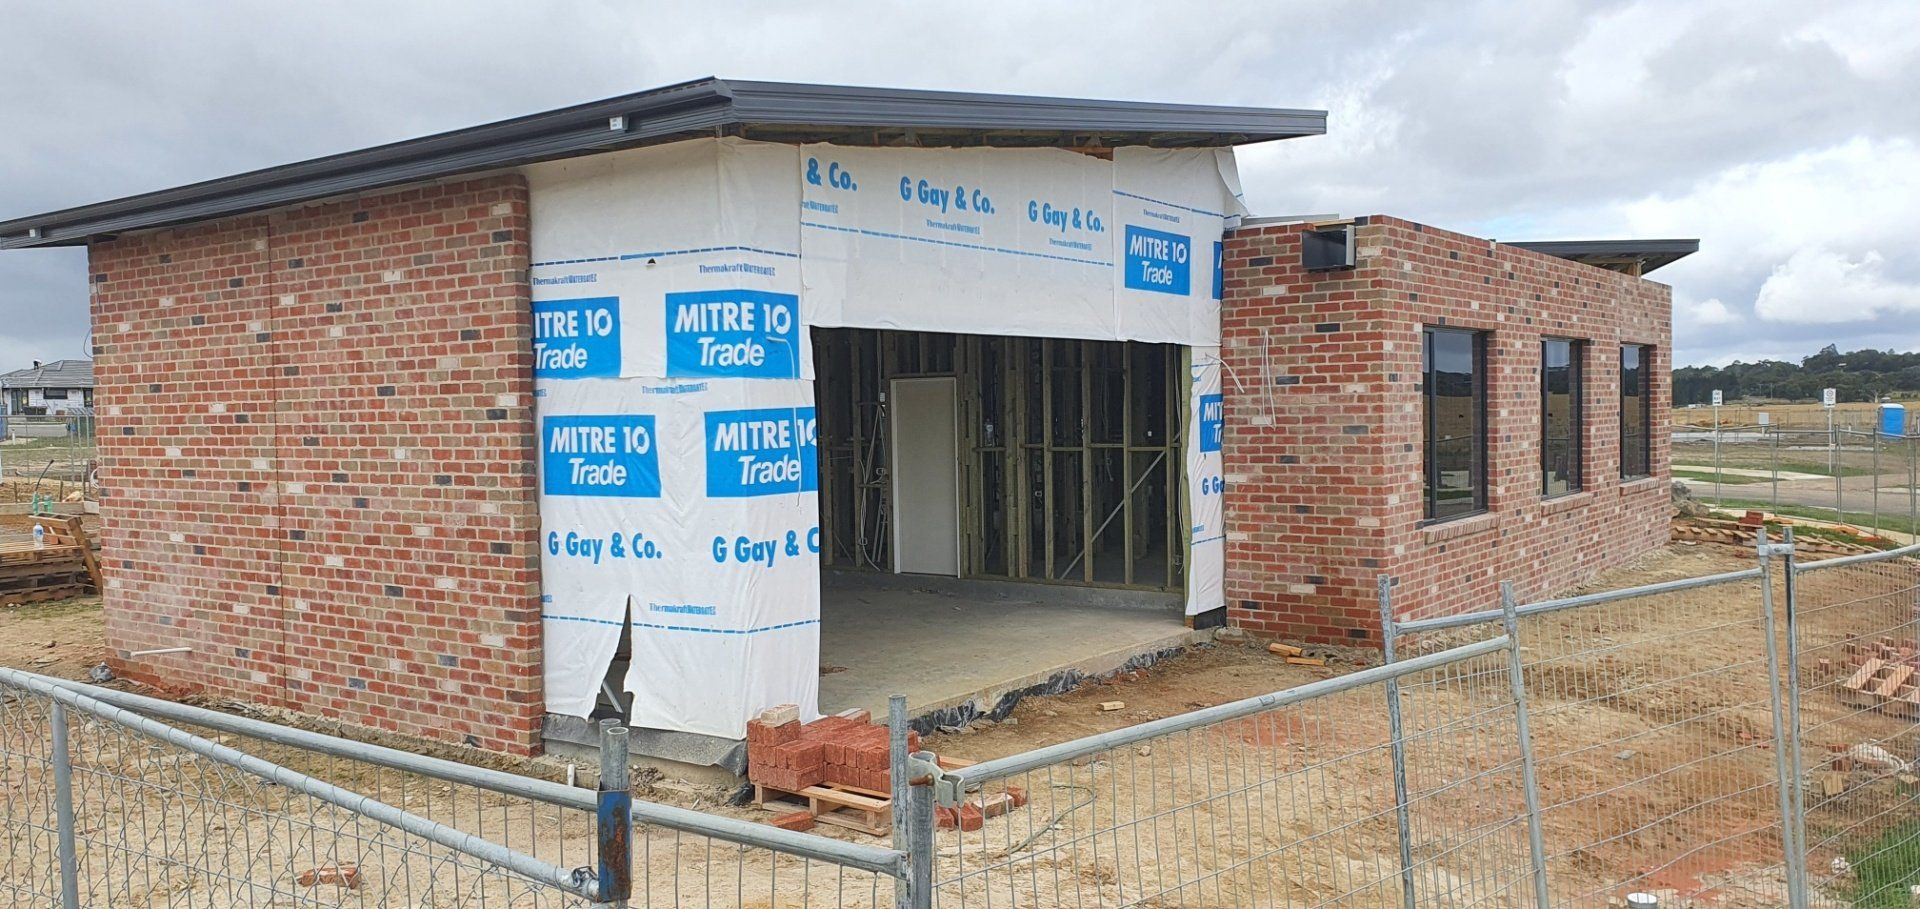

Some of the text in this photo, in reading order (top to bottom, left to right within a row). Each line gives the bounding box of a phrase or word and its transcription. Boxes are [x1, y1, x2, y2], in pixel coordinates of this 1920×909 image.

[806, 157, 857, 191] & Co.
[900, 176, 995, 214] G Gay & Co.
[1028, 200, 1104, 232] G Gay & Co.
[1130, 234, 1187, 264] MITRE 10
[1142, 261, 1173, 285] Trade
[585, 308, 613, 337] 10
[674, 302, 791, 335] MITRE 10
[534, 342, 588, 370] Trade
[697, 336, 765, 367] Trade
[550, 425, 650, 455] MITRE 10
[714, 420, 791, 452] MITRE
[568, 457, 627, 486] Trade
[738, 453, 800, 485] Trade
[1202, 477, 1209, 496] G
[548, 531, 662, 564] G Gay & Co.
[712, 536, 727, 563] G
[734, 535, 777, 567] Gay
[785, 530, 799, 557] &
